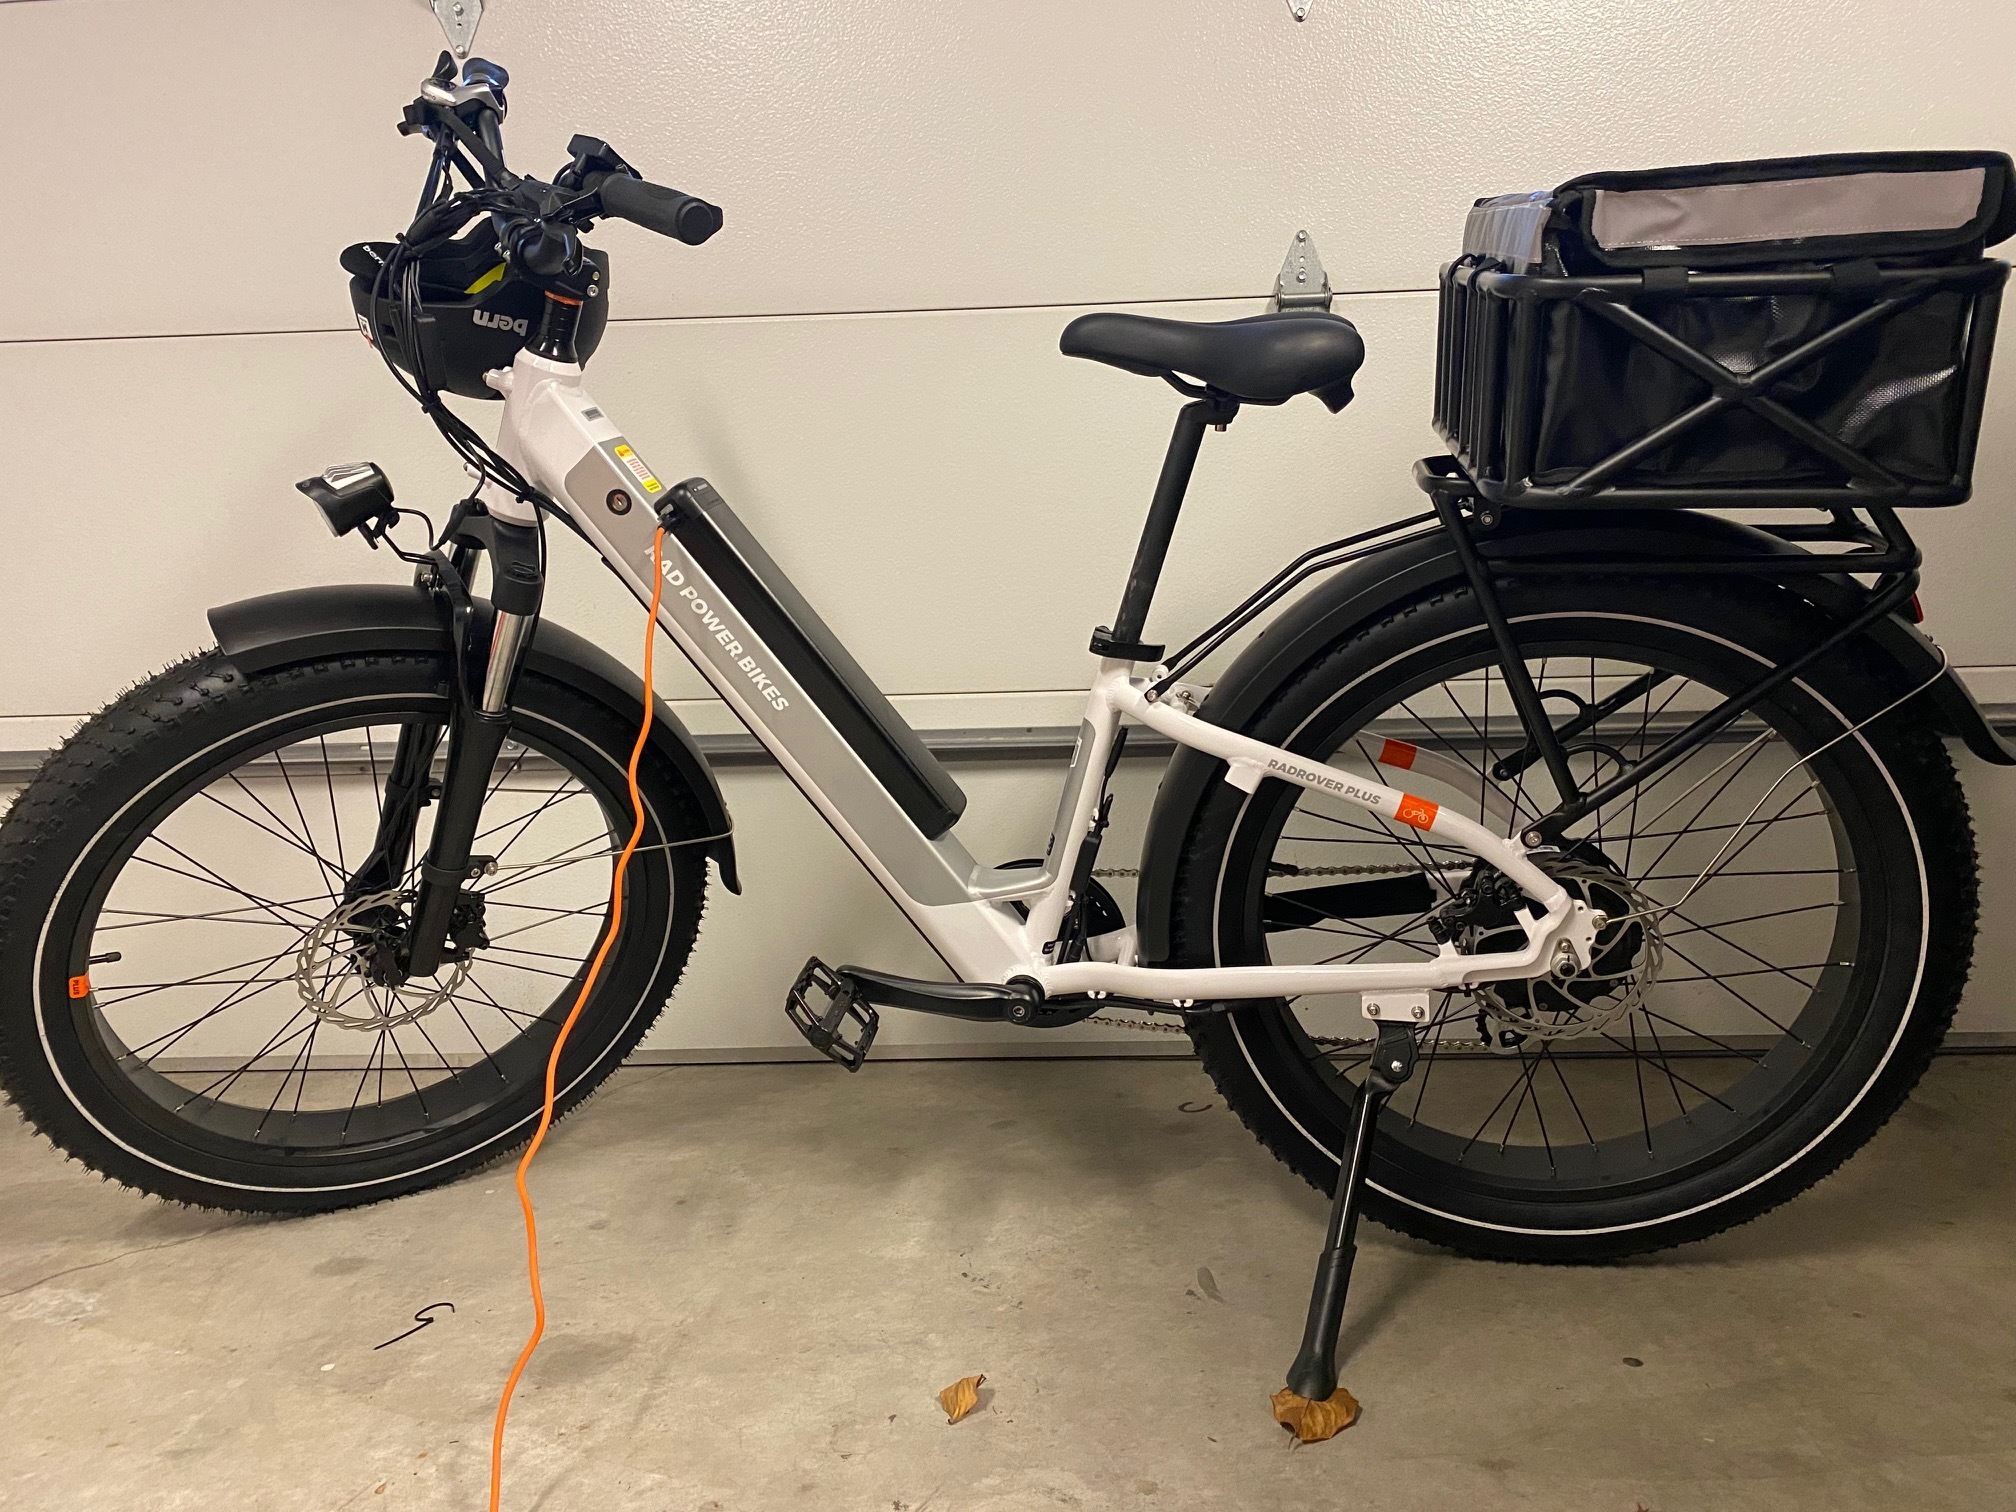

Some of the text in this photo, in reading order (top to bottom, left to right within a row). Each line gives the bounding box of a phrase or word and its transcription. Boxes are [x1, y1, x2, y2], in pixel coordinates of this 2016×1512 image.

[472, 309, 529, 337] bern
[679, 585, 744, 658] POWER
[737, 655, 789, 711] BIKES
[1267, 758, 1382, 805] RADROVER PLUS
